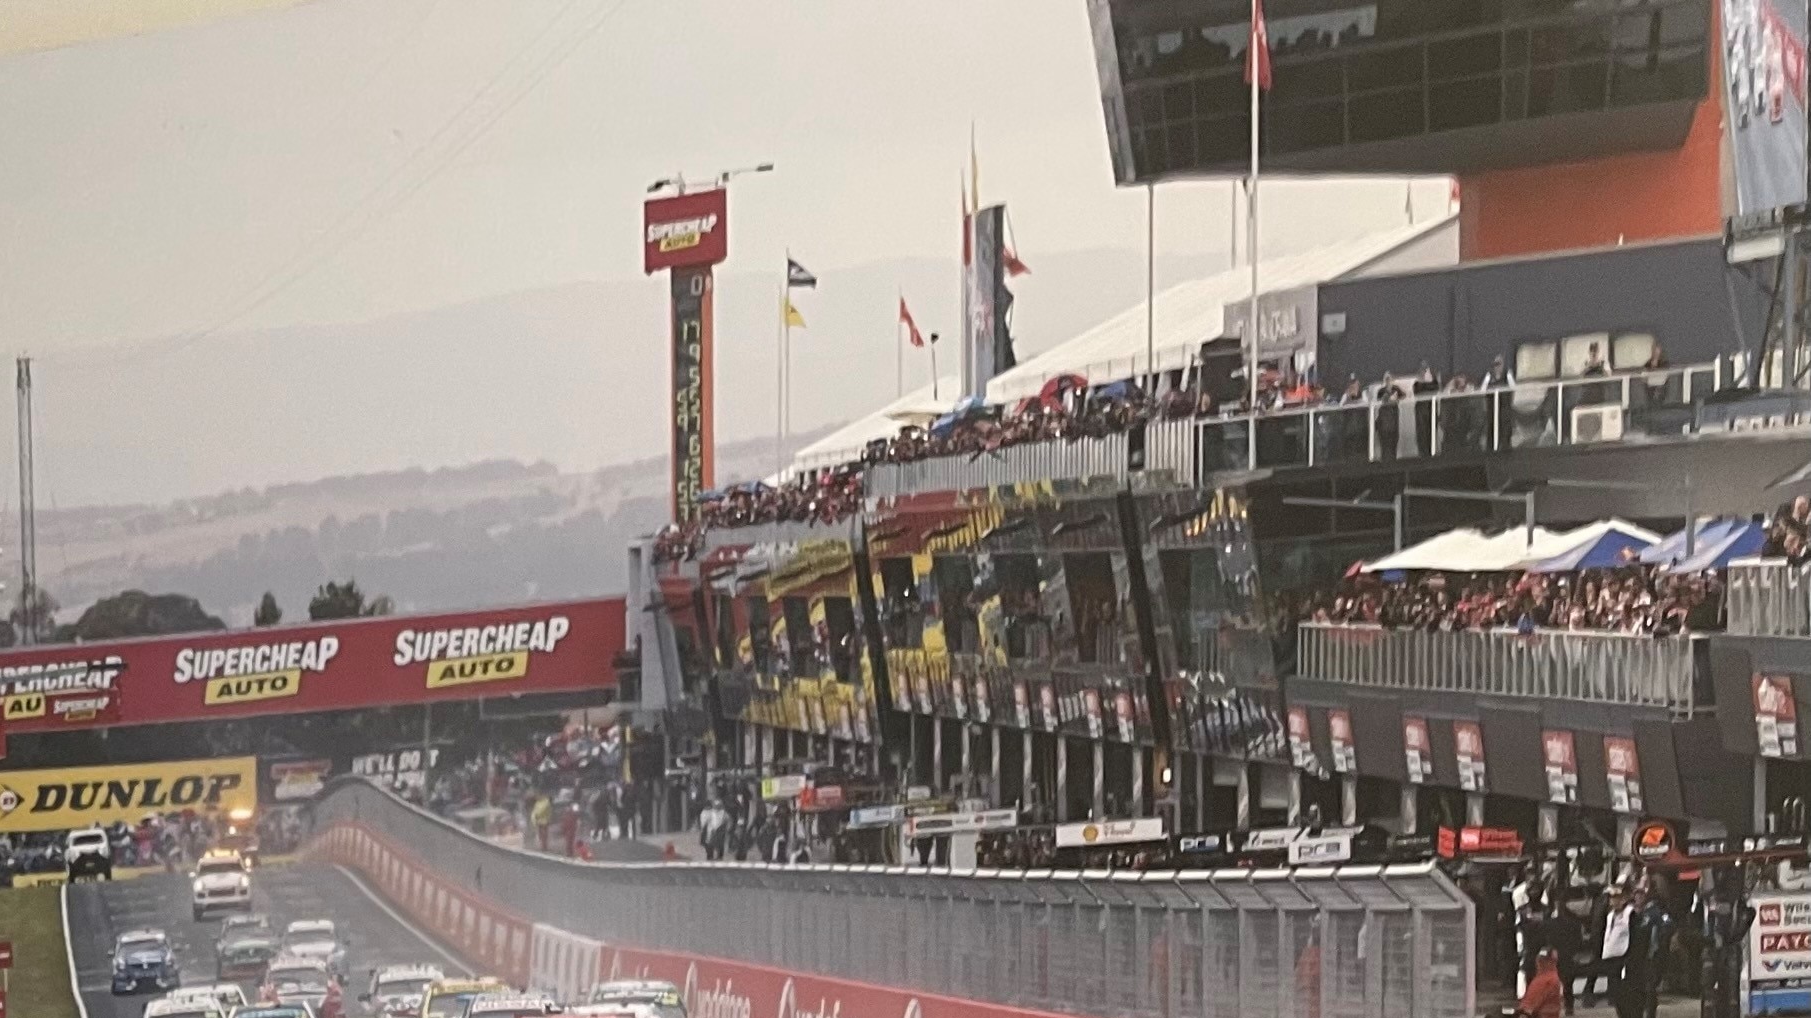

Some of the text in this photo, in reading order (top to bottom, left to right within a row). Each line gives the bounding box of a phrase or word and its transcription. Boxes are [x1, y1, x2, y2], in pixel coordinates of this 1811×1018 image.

[173, 636, 339, 684] SUPERCHEAP
[393, 616, 570, 667] SUPERCHEAP
[216, 675, 289, 699] AUTO
[438, 657, 516, 681] AUTO
[30, 772, 242, 814] DUNLOP
